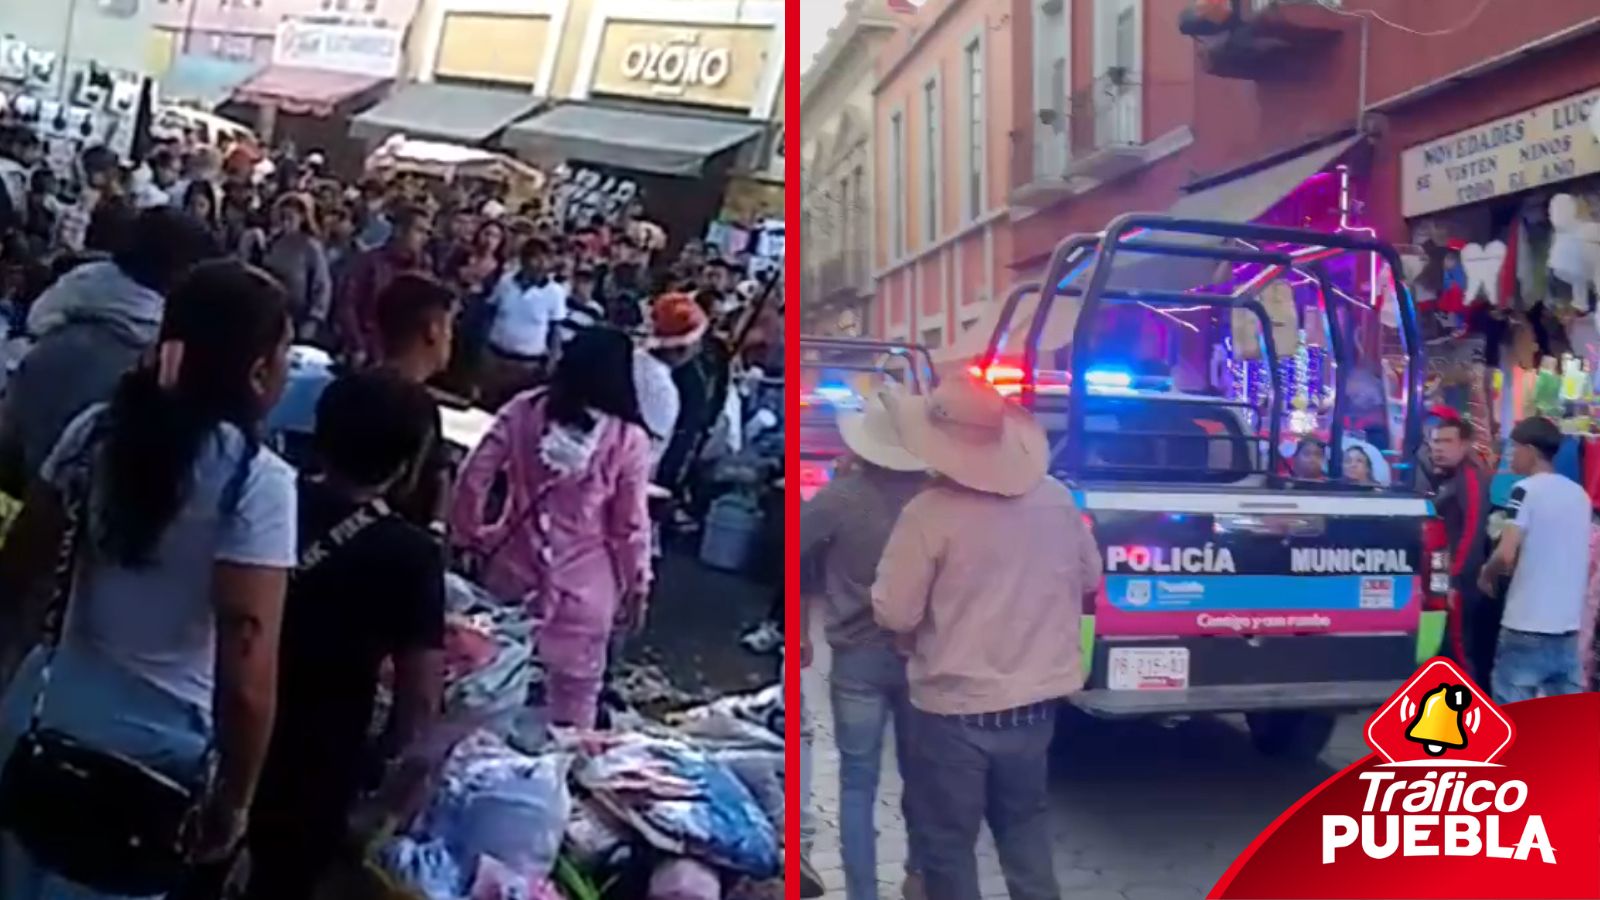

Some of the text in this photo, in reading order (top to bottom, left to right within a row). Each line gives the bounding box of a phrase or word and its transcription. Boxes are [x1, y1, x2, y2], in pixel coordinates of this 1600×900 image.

[1424, 95, 1600, 166] NOVEDADES LUC
[1106, 542, 1414, 574] POLICÍA MUNICIPAL
